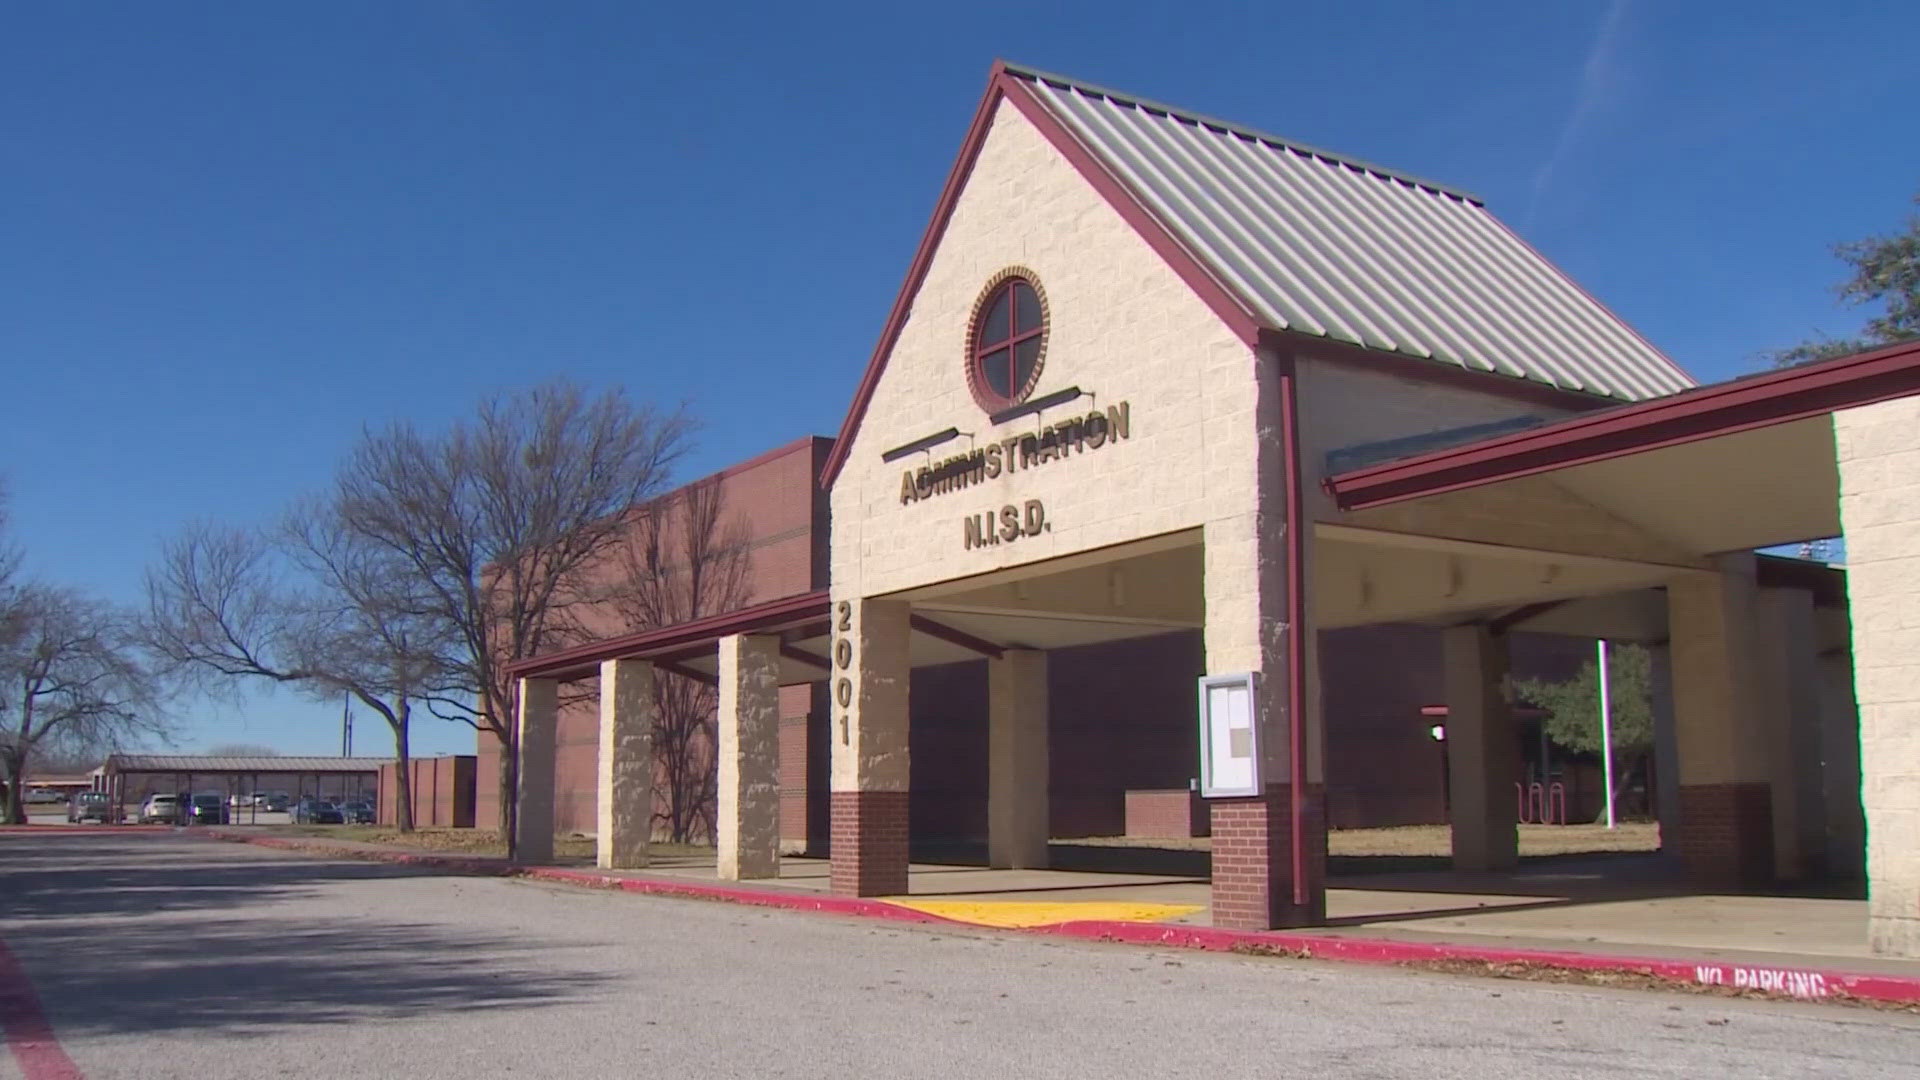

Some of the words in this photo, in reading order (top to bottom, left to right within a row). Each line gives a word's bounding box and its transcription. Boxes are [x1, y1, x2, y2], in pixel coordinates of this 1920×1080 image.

[900, 401, 1129, 505] ADMINISTRATION
[964, 499, 1051, 550] N.I.S.D.
[836, 601, 852, 746] 2001
[1697, 966, 1722, 985] NO
[1735, 968, 1827, 997] PARKING
